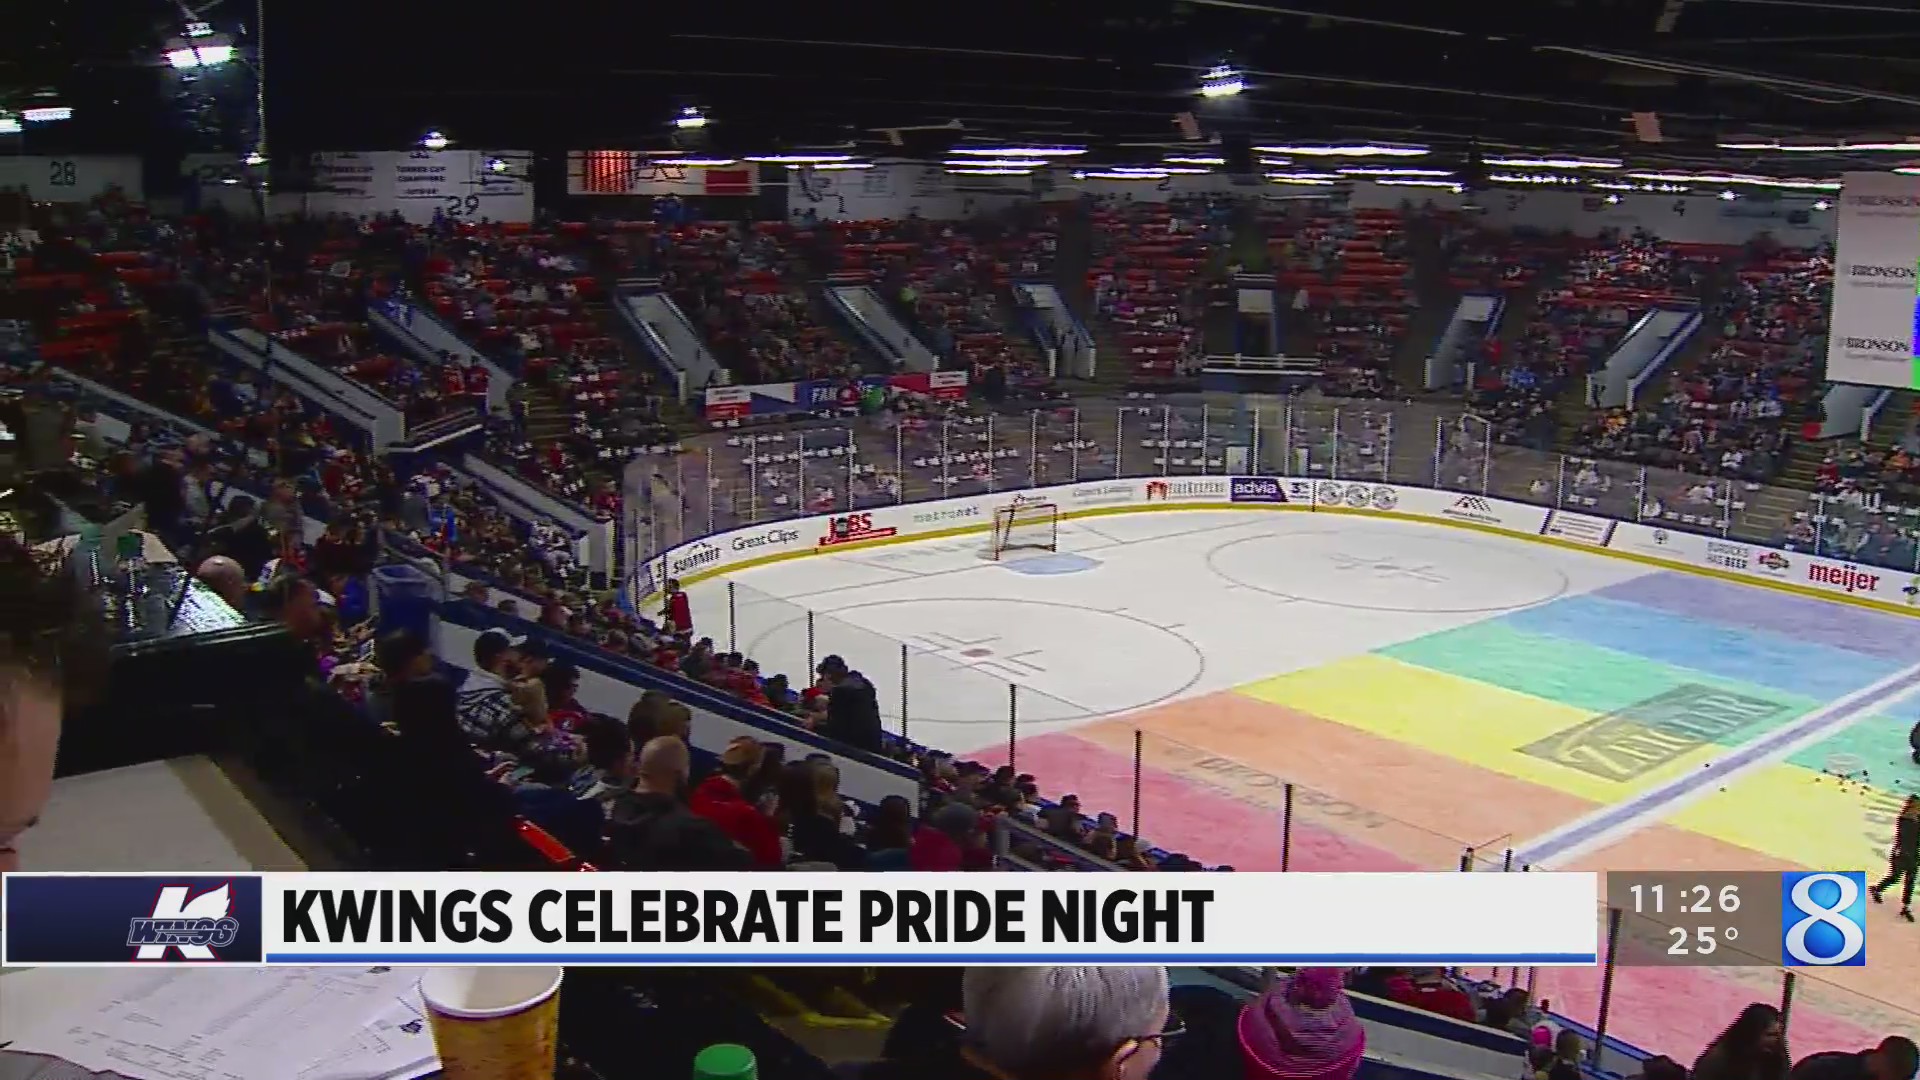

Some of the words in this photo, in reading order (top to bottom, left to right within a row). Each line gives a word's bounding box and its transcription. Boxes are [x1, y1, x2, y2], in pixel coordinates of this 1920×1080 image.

[50, 161, 77, 186] 28
[447, 195, 480, 216] 29
[1847, 337, 1911, 352] BRONSON
[1234, 480, 1278, 494] advia
[732, 534, 767, 551] Great
[768, 529, 800, 546] Clips
[673, 547, 721, 575] SUMMIT
[1809, 562, 1880, 592] meijer
